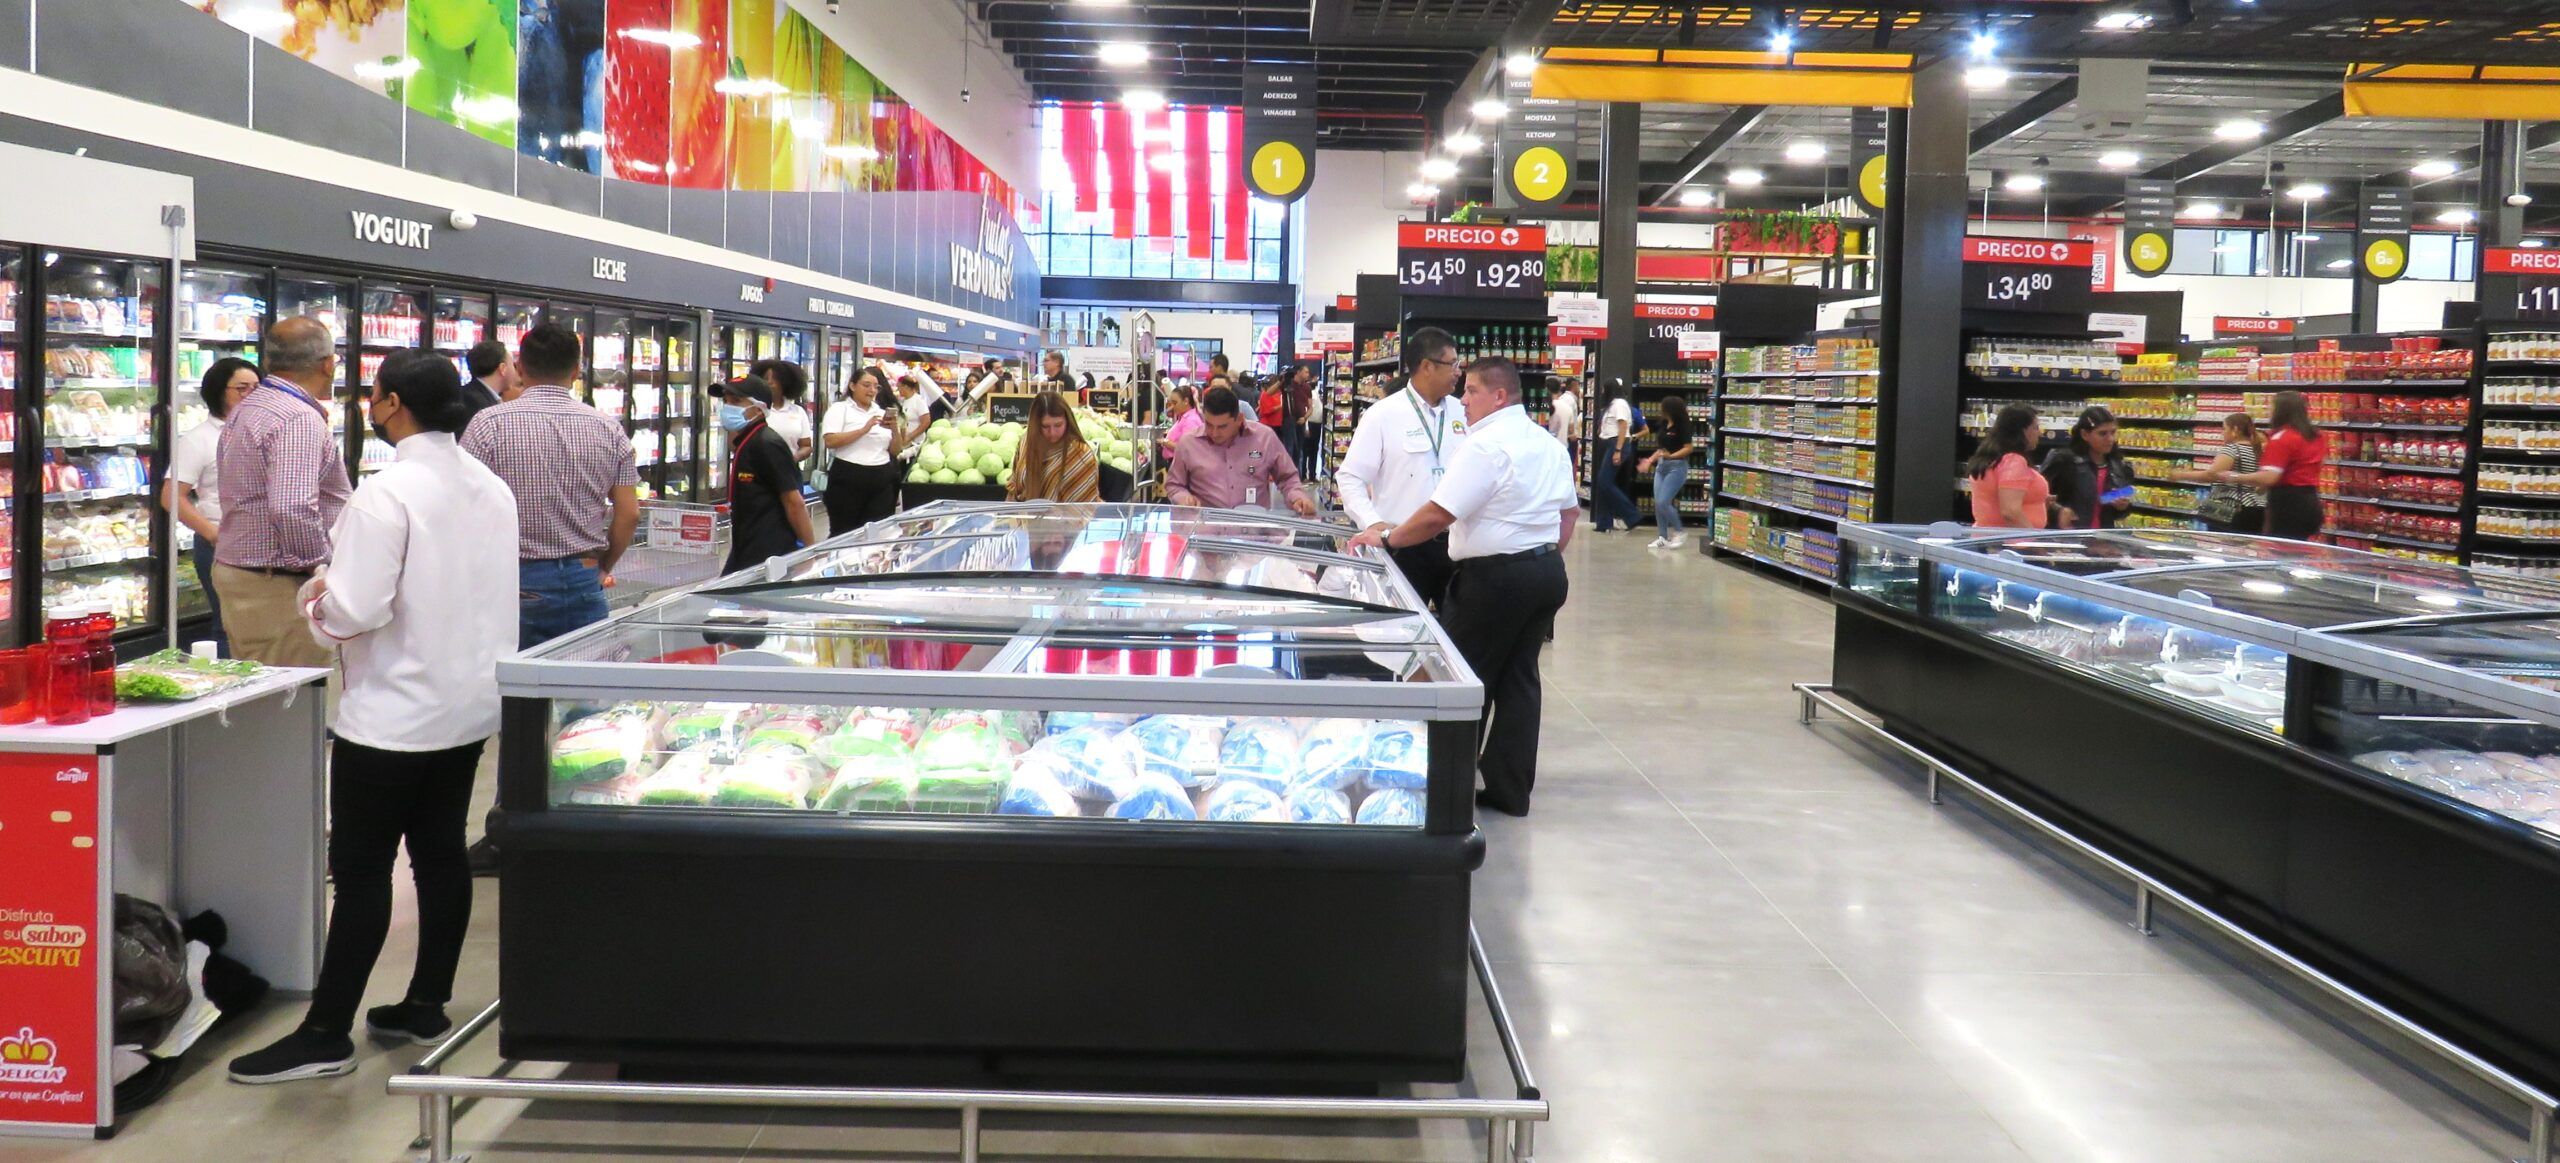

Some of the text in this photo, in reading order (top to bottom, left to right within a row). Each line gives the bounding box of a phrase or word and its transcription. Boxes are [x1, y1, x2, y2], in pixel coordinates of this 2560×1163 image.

[1267, 75, 1293, 83] SALSAS
[1262, 92, 1298, 100] ADEREZOS
[1263, 109, 1297, 117] VINAGRES
[1524, 114, 1557, 122] MOSTAZA
[1525, 131, 1557, 139] KETCHUP
[1272, 158, 1283, 179] 1
[1532, 162, 1550, 184] 2
[351, 210, 433, 250] YOGURT
[1425, 228, 1496, 244] PRECIO
[1977, 242, 2046, 259] PRECIO
[592, 256, 627, 283] LECHE
[949, 241, 1007, 303] VERDURAS
[740, 283, 764, 304] JUGOS
[808, 297, 826, 314] FRUTA
[1647, 306, 1687, 316] PRECIO
[2227, 320, 2266, 329] PRECIO
[56, 767, 89, 784] Cargill
[0, 908, 54, 923] Disfruta
[3, 926, 82, 944] su sabor
